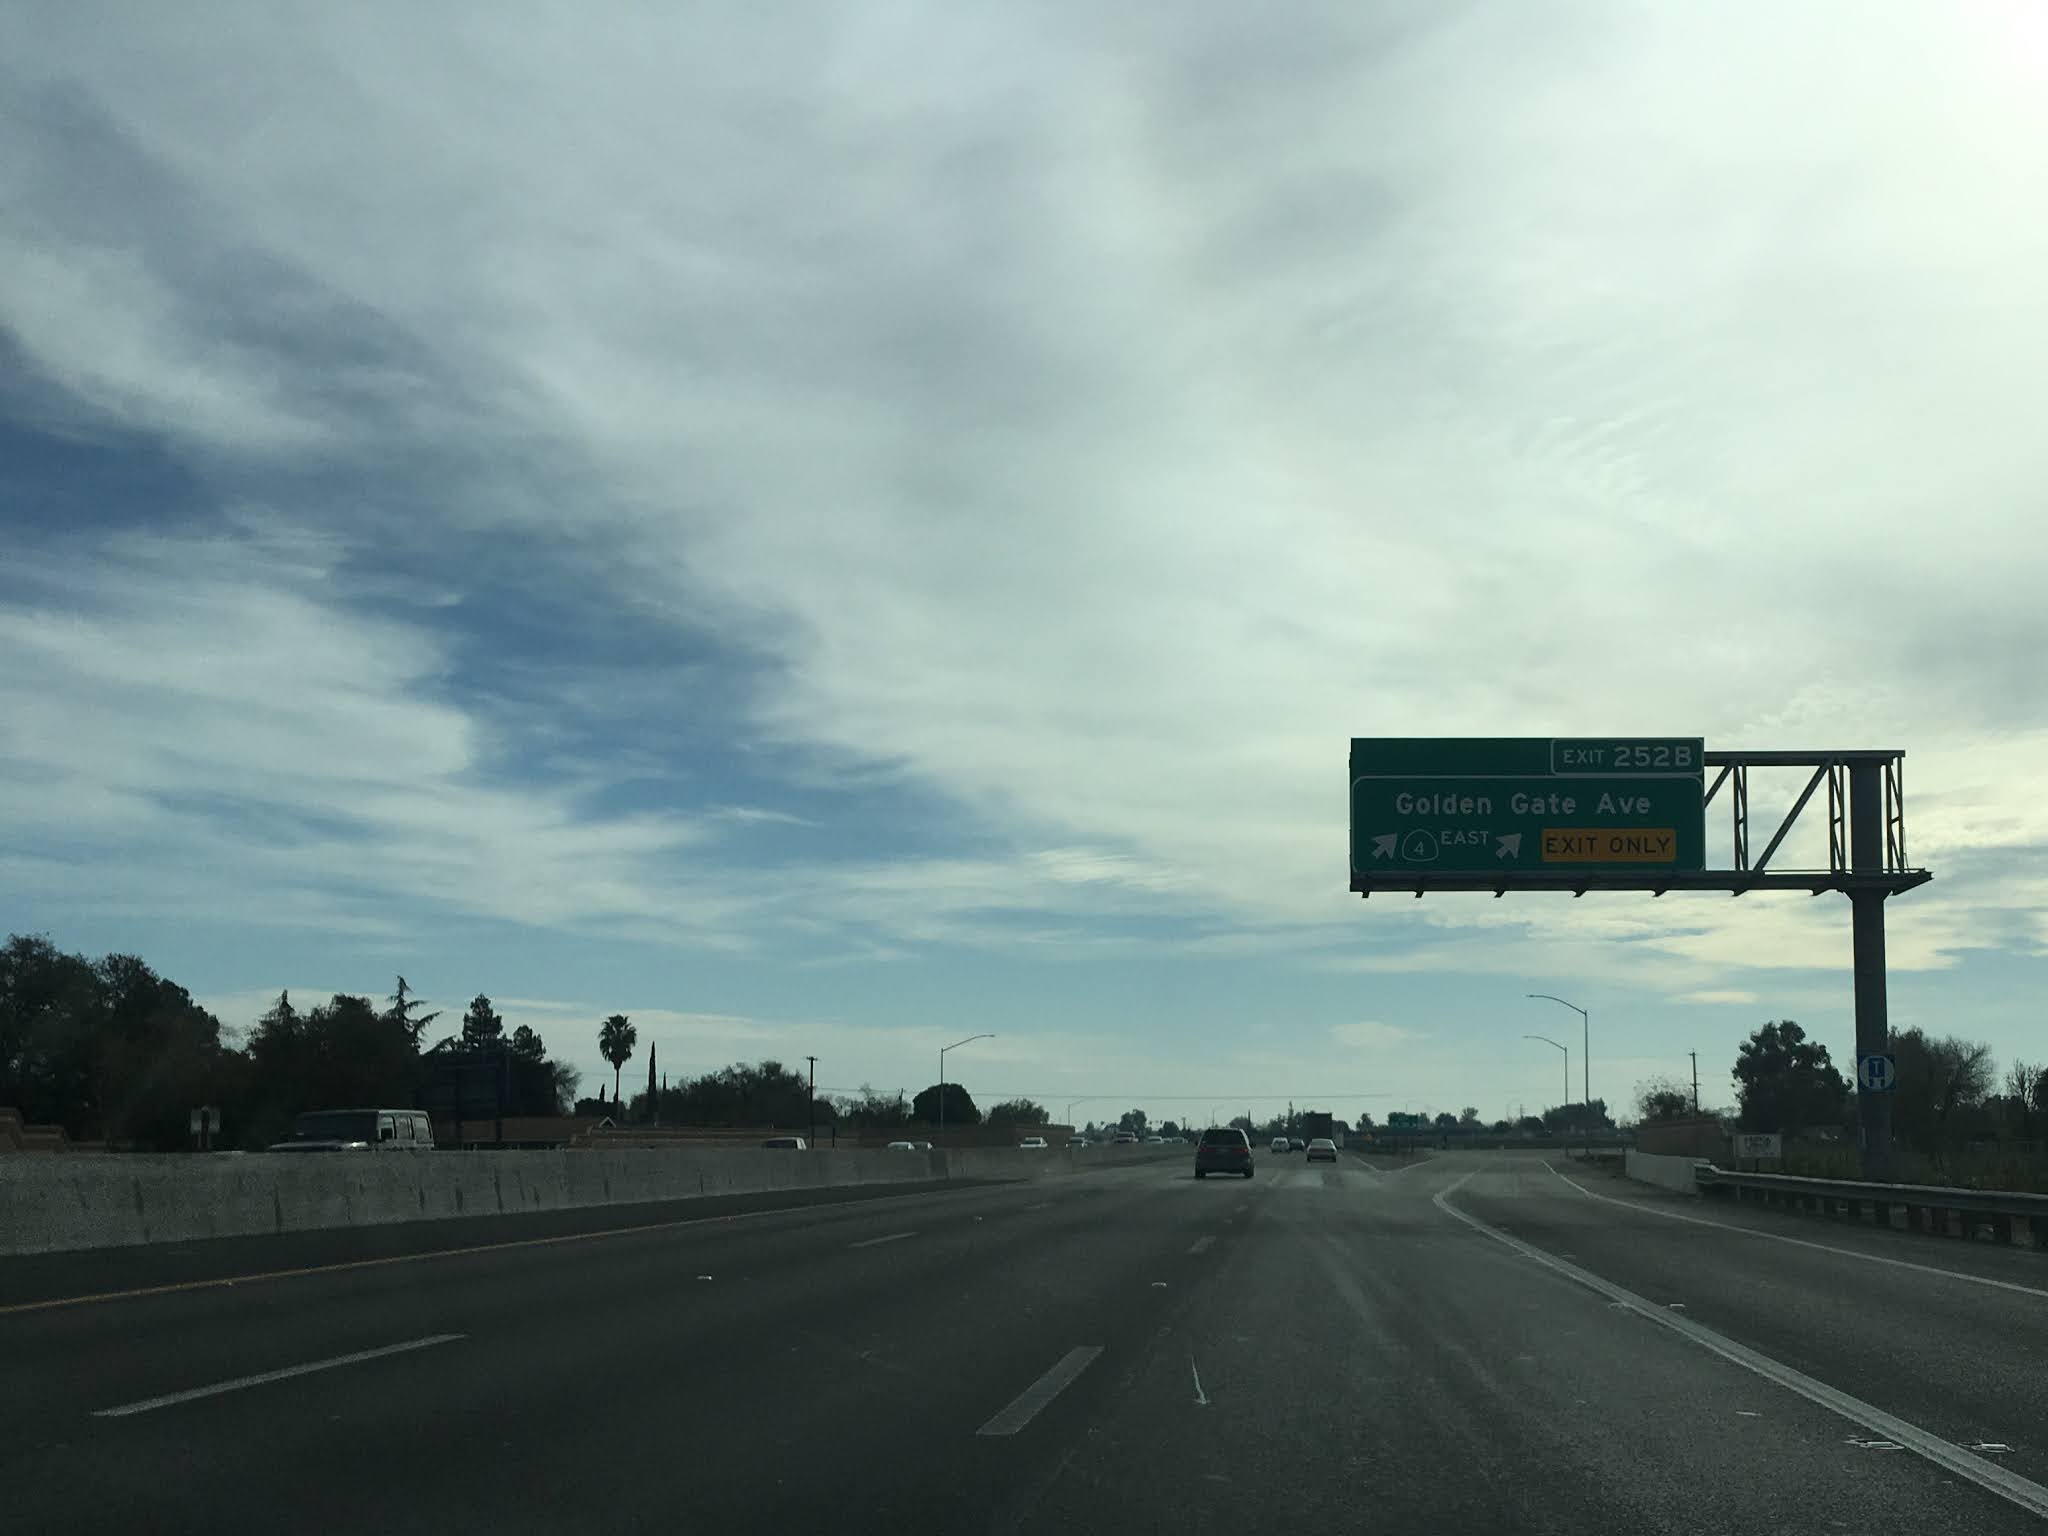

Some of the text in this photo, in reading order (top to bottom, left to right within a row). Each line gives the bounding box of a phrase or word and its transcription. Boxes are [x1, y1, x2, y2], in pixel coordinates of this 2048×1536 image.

[1563, 746, 1693, 767] EXIT 252B
[1395, 792, 1651, 815] Golden Gate Ave
[1412, 831, 1489, 856] 4 EAST
[1545, 837, 1671, 854] EXIT ONLY
